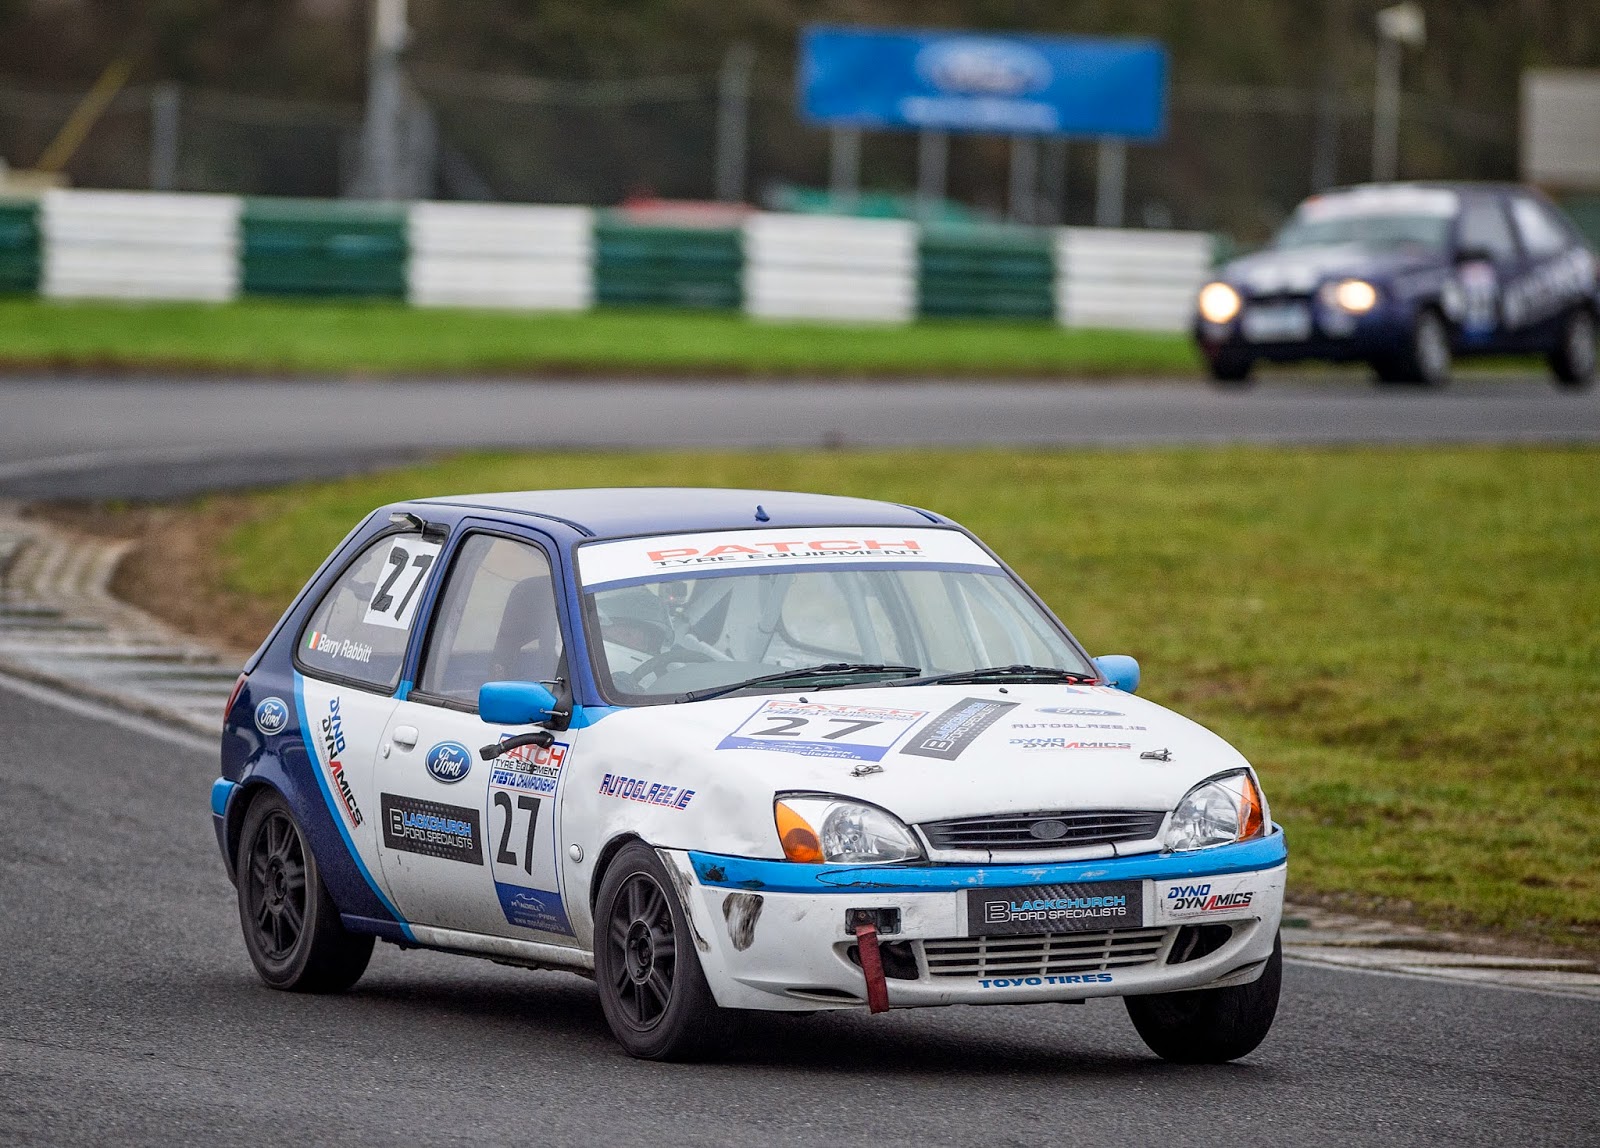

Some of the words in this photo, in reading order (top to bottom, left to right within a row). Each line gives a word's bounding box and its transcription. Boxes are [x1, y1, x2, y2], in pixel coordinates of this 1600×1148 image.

[647, 540, 921, 561] PATCH
[653, 555, 735, 566] TYRE
[748, 550, 921, 559] EQUIPMENT
[371, 546, 435, 622] 27
[317, 633, 343, 659] Barry
[340, 639, 373, 663] Rabbitt
[330, 696, 346, 753] DYNO
[749, 717, 885, 740] 27
[501, 740, 565, 768] ATCH
[1023, 742, 1131, 750] DYNAMICS
[322, 715, 363, 828] DYNAMICS
[433, 746, 461, 778] Ford
[495, 759, 514, 770] TYRE
[516, 762, 559, 776] EQUPMENT
[491, 770, 516, 787] FIESTA
[599, 773, 696, 810] AUTOGLAZE.IE
[389, 808, 472, 838] BLACKCHURCH
[494, 791, 541, 876] 27
[405, 828, 425, 841] FORD
[427, 830, 474, 851] SPECIALISTS
[1168, 884, 1211, 899] DYNO
[1173, 892, 1253, 910] DYNAMICS
[984, 895, 1126, 924] BLACKCHURCH
[1011, 910, 1047, 921] FORD
[1049, 906, 1127, 920] SPECIALISTS
[978, 975, 1042, 988] TOYO
[1044, 973, 1113, 985] TIRES
